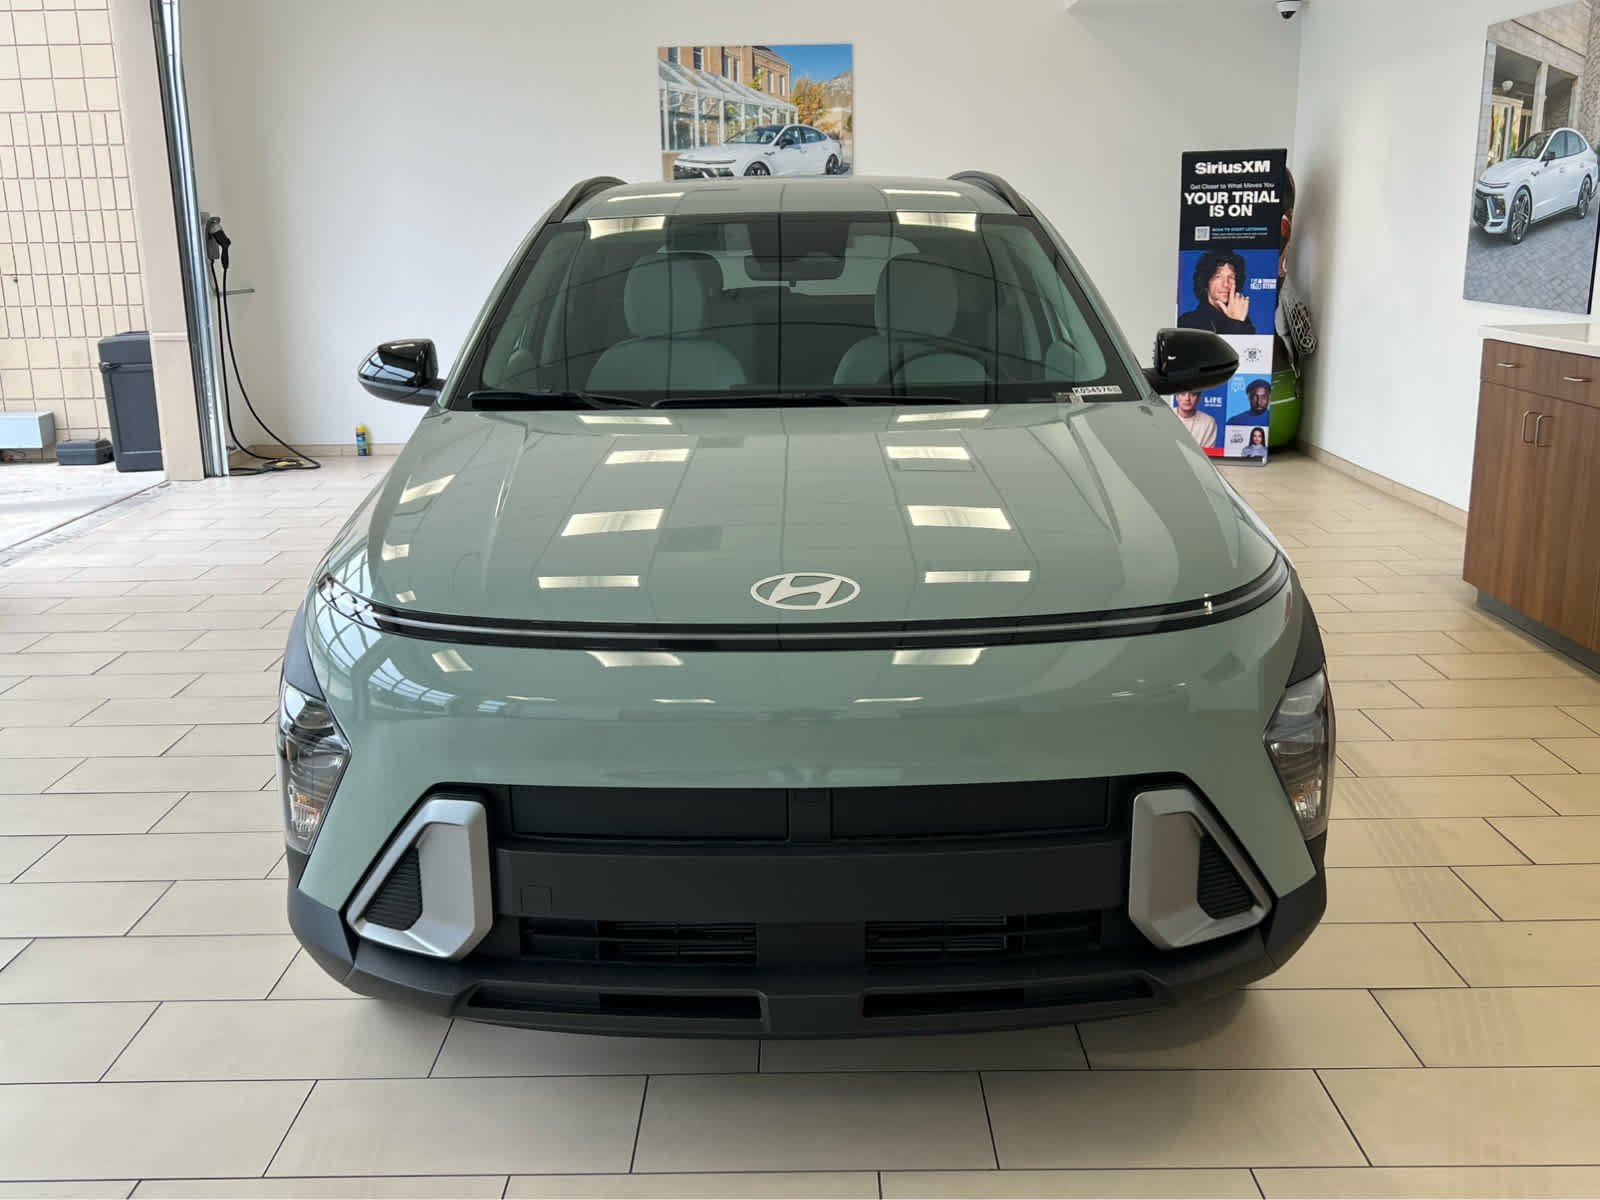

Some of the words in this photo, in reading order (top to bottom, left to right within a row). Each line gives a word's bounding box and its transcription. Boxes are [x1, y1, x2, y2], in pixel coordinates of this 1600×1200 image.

[1195, 160, 1271, 175] SiriusXM
[1184, 191, 1228, 205] YOUR
[1232, 190, 1280, 204] TRIAL
[1209, 205, 1224, 217] IS
[1228, 205, 1253, 217] ON
